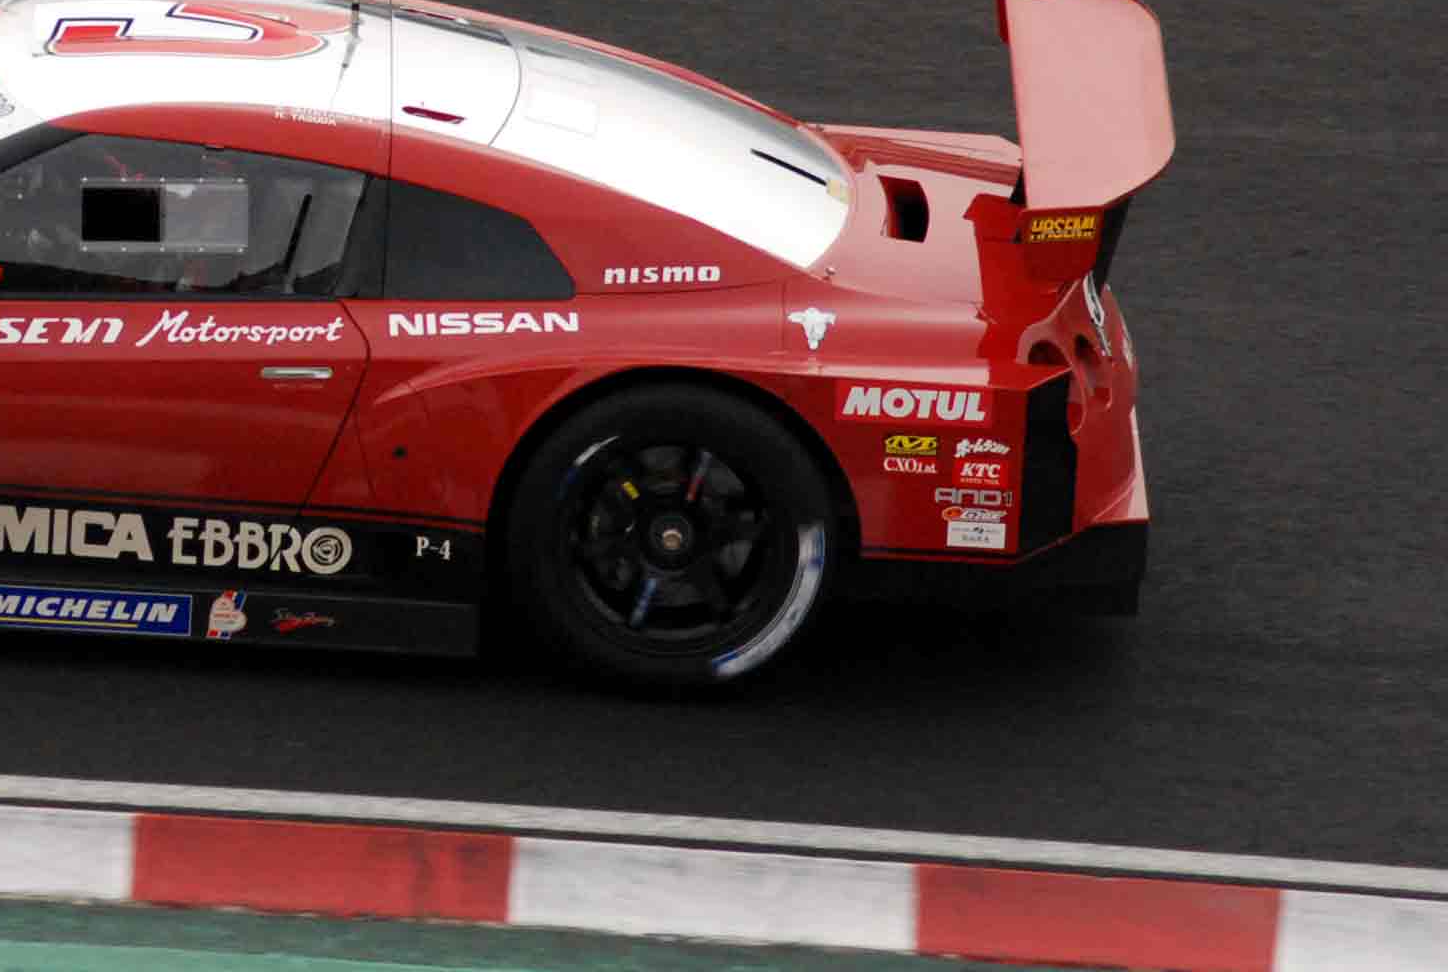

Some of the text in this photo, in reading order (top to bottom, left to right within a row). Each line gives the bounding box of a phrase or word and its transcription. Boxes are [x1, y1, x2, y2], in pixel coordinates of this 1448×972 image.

[136, 309, 345, 347] Motorsport
[388, 312, 579, 337] NISSAN
[842, 386, 986, 421] MOTUL
[960, 462, 1001, 478] KTC
[167, 515, 353, 575] EBBRO
[415, 536, 452, 561] P-4
